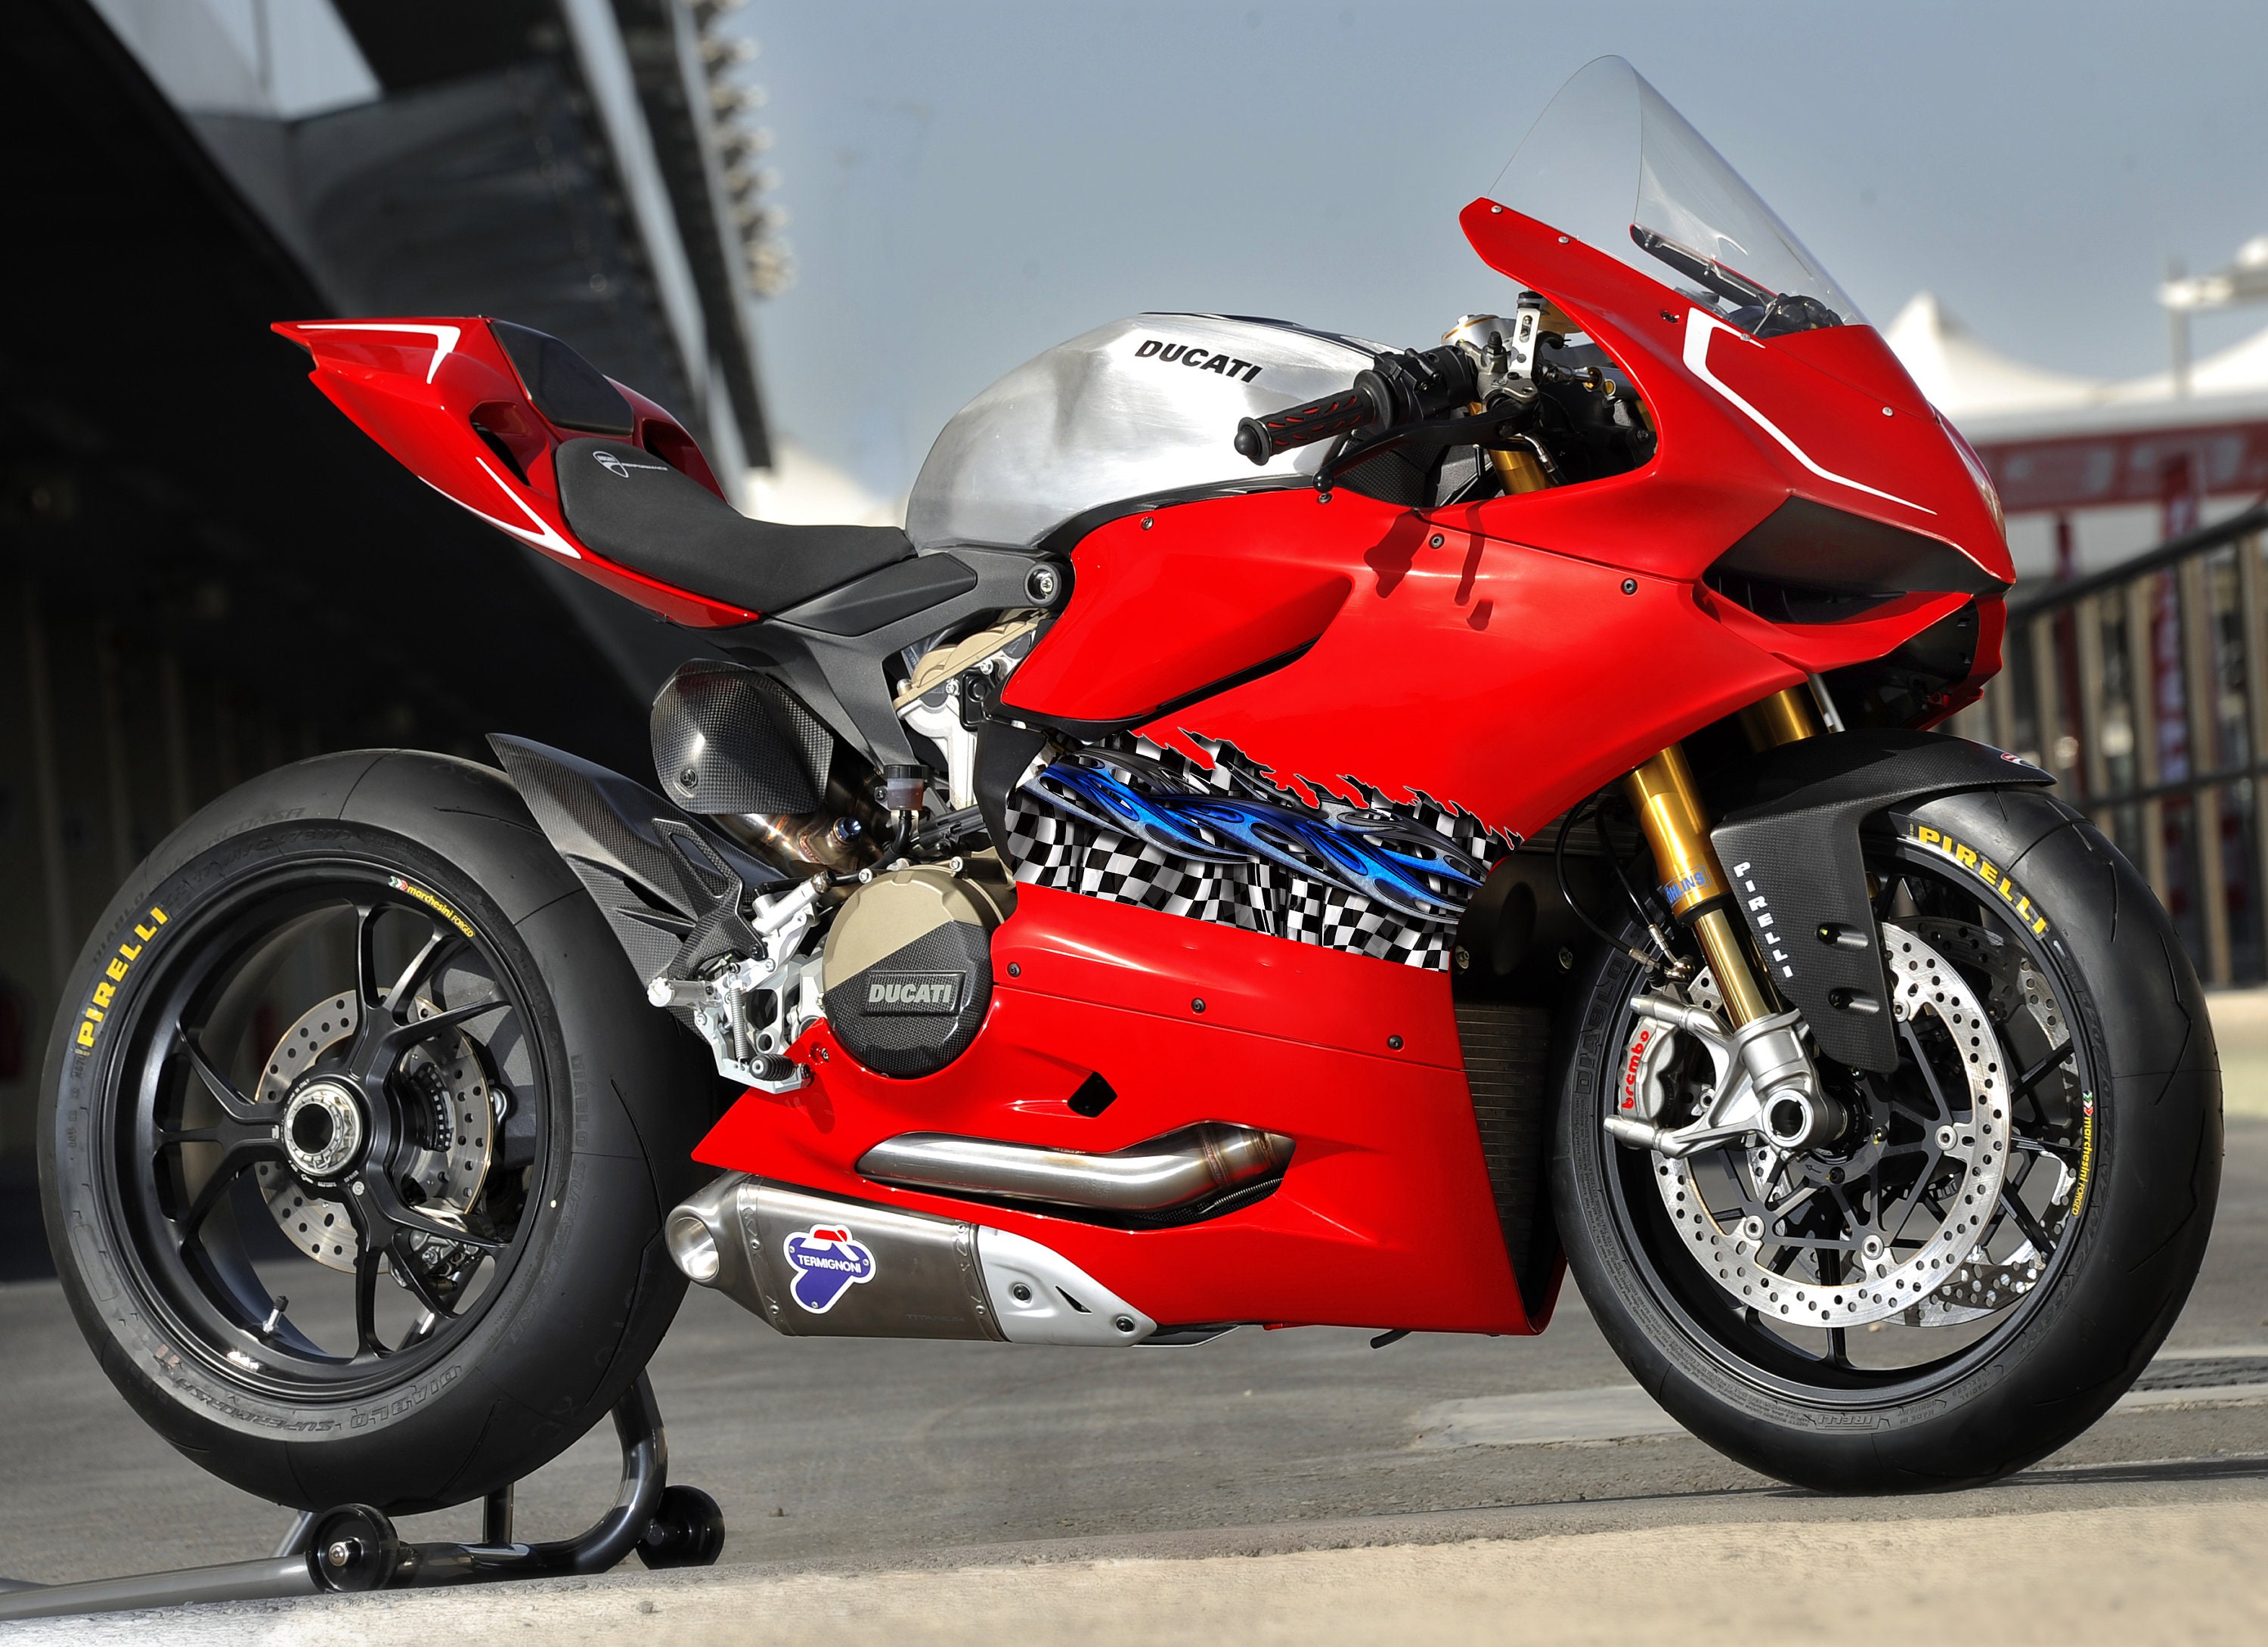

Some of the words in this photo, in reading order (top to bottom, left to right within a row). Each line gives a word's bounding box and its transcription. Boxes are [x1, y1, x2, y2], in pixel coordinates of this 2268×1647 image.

[1134, 340, 1263, 383] DUCATI
[1665, 871, 1706, 904] ÖHLINS
[1918, 825, 2047, 935] PIRELLI
[407, 886, 454, 918] marchesini
[451, 914, 475, 938] FORGED
[1733, 861, 1793, 978] PIRELLI
[77, 907, 169, 1048] PIRELLI
[868, 984, 953, 1003] DUCATI
[1575, 957, 1626, 1095] DIABLO
[1622, 1031, 1650, 1109] brembo
[2080, 1116, 2093, 1183] marchesini
[2071, 1183, 2086, 1216] FORGED
[797, 1254, 862, 1273] TERMIGNONI
[349, 1360, 464, 1428] DIABLO
[1816, 1413, 1882, 1431] PIRELLI
